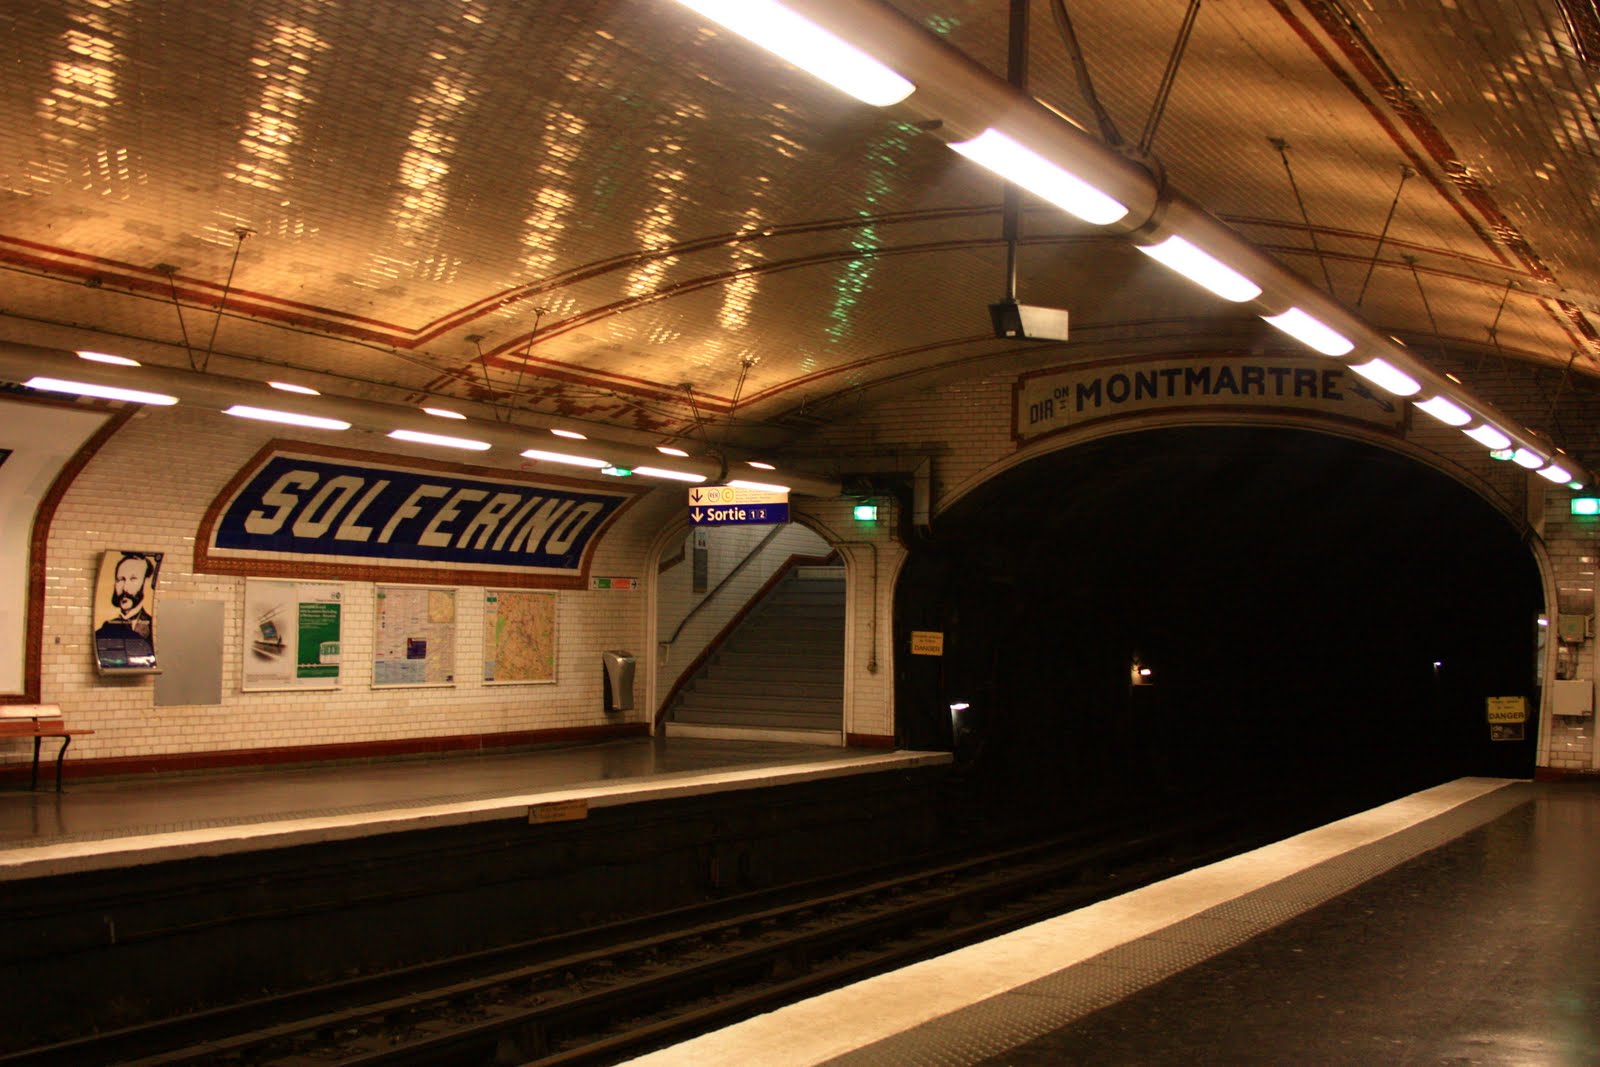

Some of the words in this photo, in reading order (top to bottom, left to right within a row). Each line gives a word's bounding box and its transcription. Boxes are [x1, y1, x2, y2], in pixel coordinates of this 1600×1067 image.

[1030, 398, 1053, 424] DIR
[1076, 366, 1344, 412] MONTMARTRE
[244, 469, 604, 555] SOLFERINO
[707, 507, 746, 521] Sortie
[1489, 712, 1524, 720] DANGER
